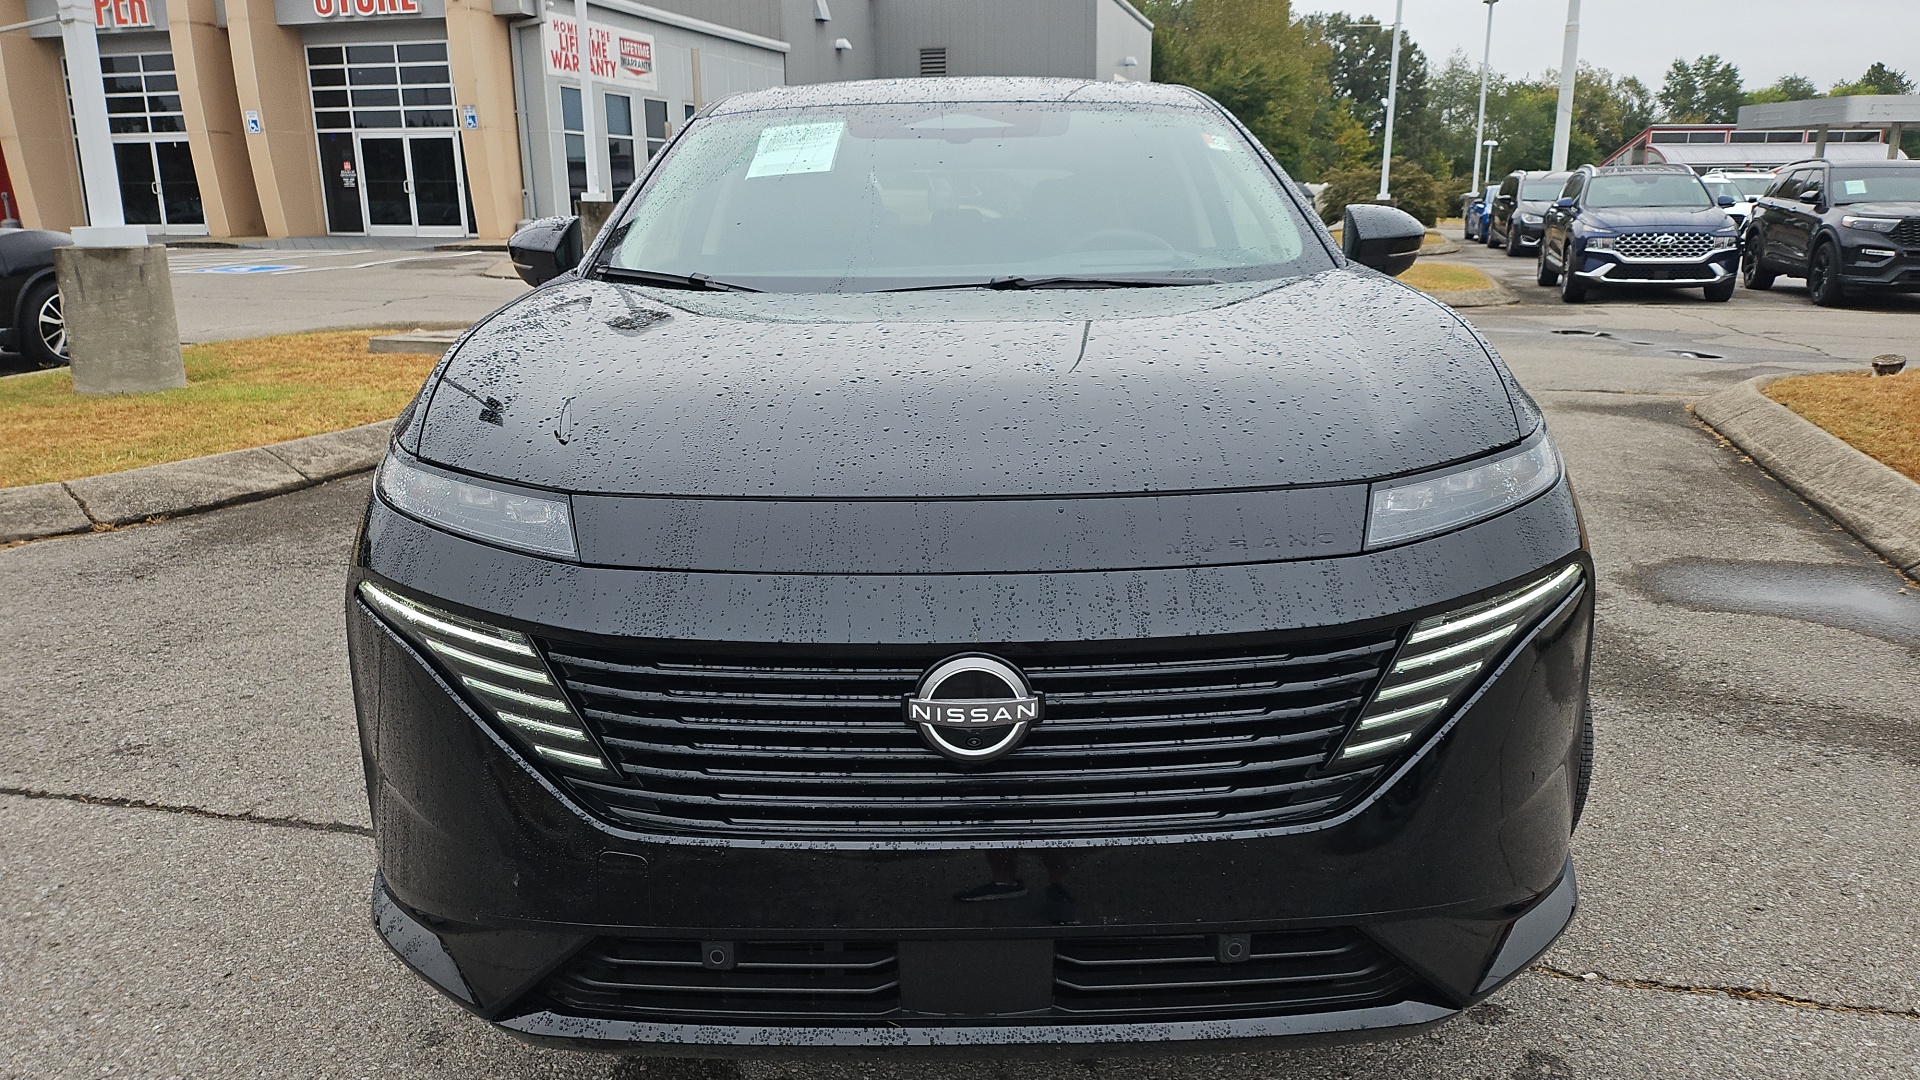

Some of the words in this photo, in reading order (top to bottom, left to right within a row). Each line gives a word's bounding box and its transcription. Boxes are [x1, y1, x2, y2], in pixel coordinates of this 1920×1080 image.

[596, 29, 610, 42] THE
[620, 40, 651, 59] LIFETIME
[551, 50, 617, 78] WARANTY
[912, 702, 1036, 723] NISSAN
